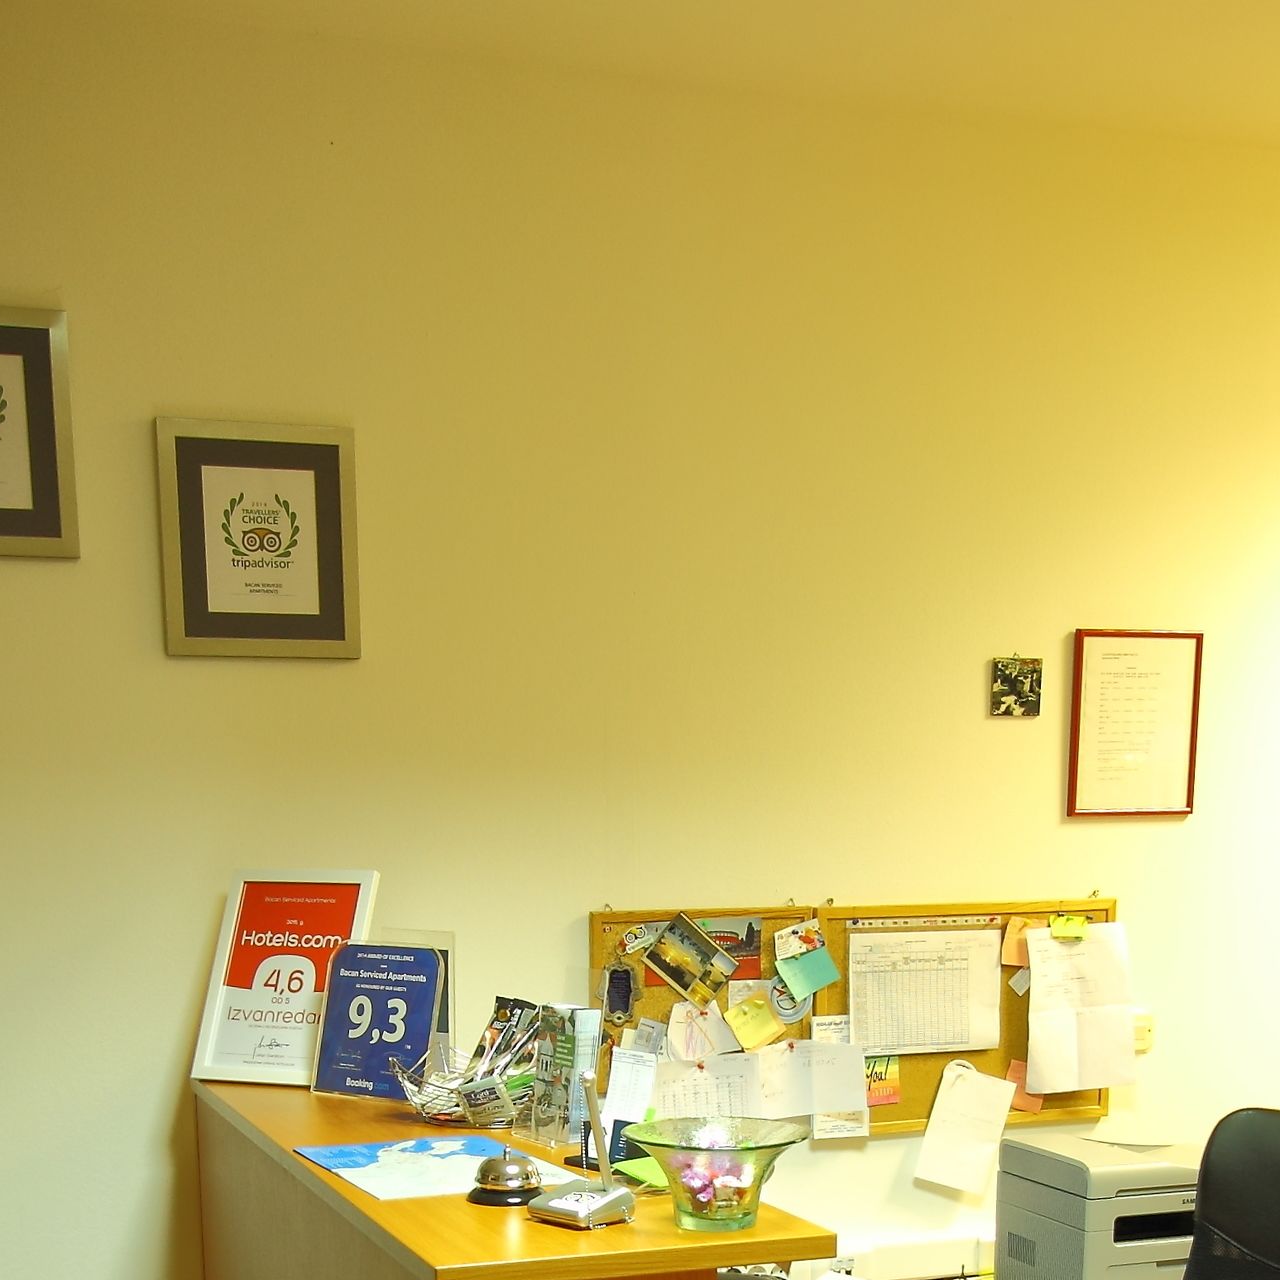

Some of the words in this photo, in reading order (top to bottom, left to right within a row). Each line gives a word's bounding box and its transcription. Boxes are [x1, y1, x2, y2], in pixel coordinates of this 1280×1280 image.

[242, 515, 278, 525] CHOICE
[231, 557, 291, 570] tripadvisor
[305, 897, 337, 905] Apartments
[240, 929, 343, 949] Hotels.com
[263, 968, 306, 996] 4,6
[339, 967, 359, 978] Bacan
[359, 968, 388, 981] Serviced
[387, 970, 428, 984] Apartments
[271, 996, 283, 1005] OD
[347, 994, 408, 1045] 9,3
[345, 1076, 390, 1092] Booking.com
